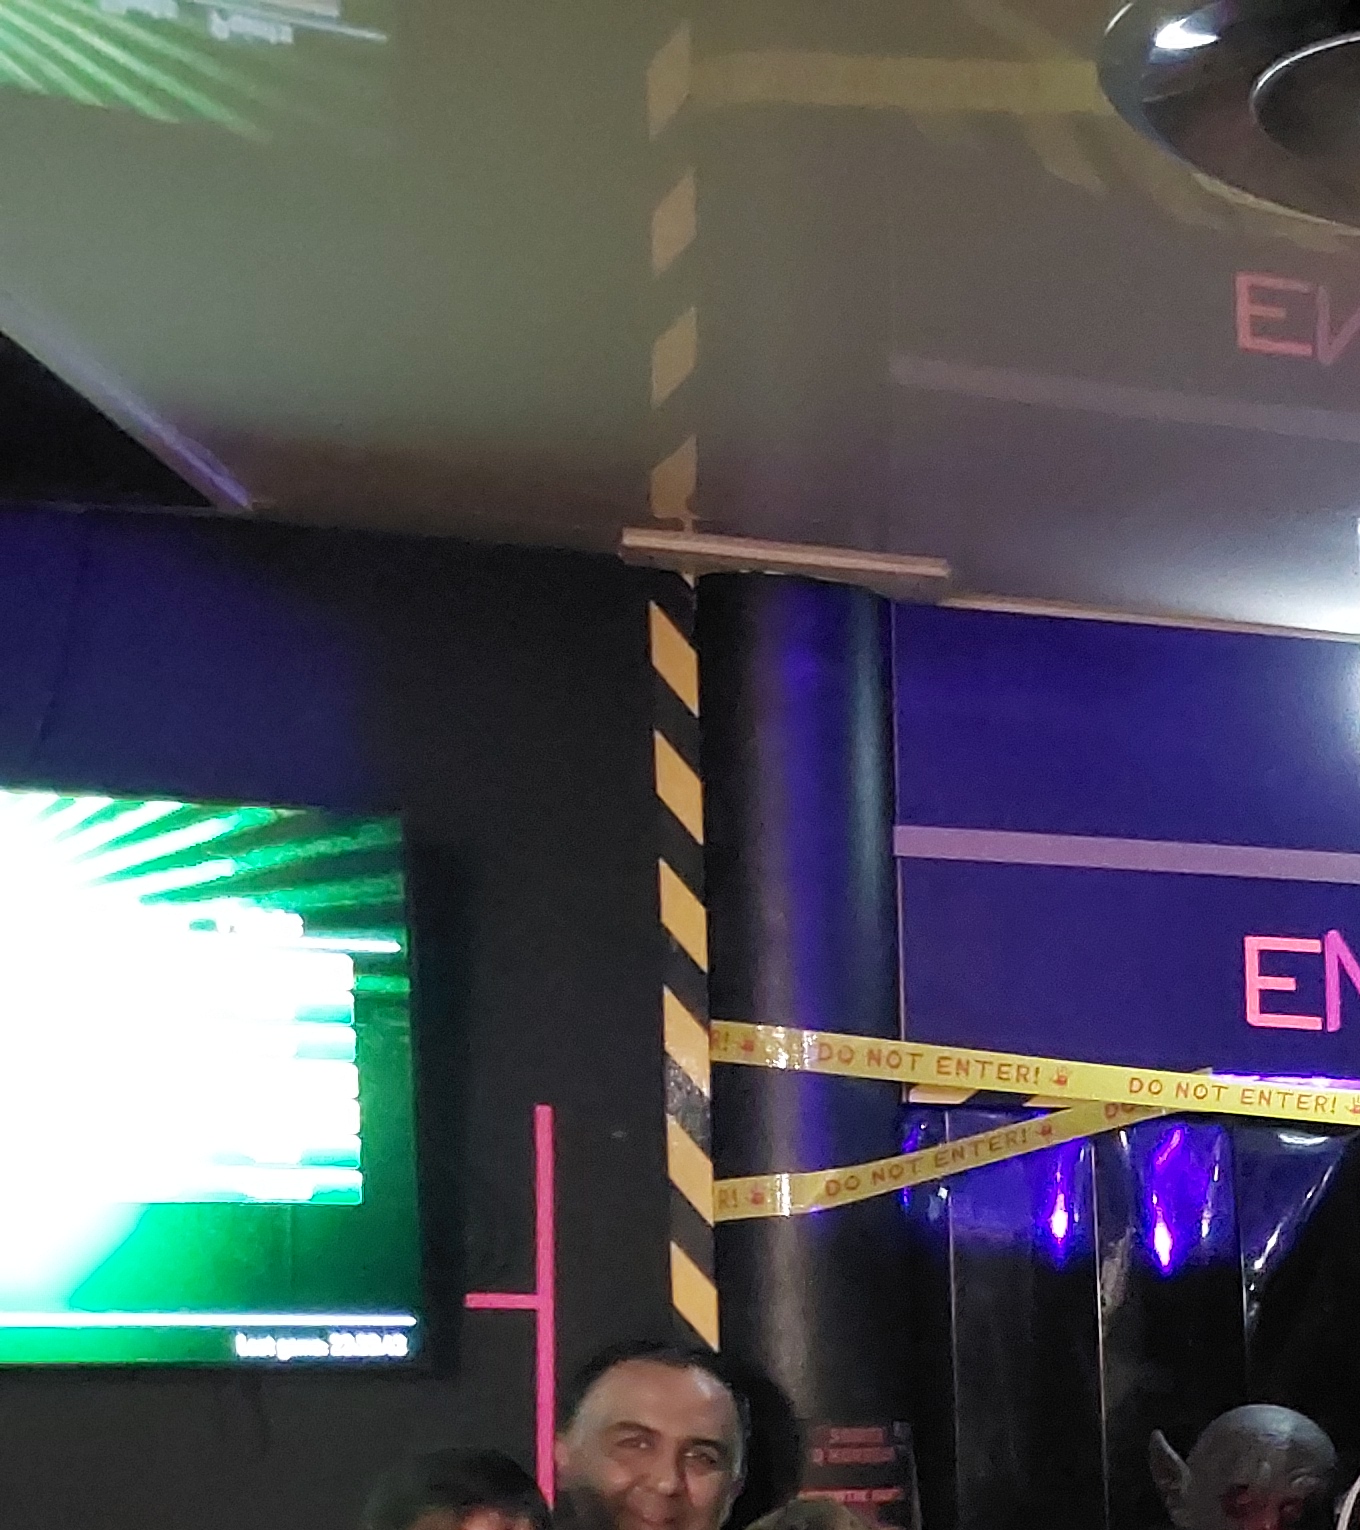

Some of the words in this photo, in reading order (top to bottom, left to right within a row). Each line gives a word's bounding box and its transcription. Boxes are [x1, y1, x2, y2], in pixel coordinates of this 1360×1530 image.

[817, 1042, 854, 1065] DO
[867, 1049, 925, 1072] NOT
[936, 1056, 1041, 1085] ENTER!
[1128, 1077, 1163, 1096] DO
[1175, 1081, 1228, 1101] NOT
[1240, 1087, 1338, 1114] ENTER!
[825, 1174, 861, 1197] DO
[871, 1158, 925, 1185] NOT
[934, 1127, 1028, 1169] ENTER!
